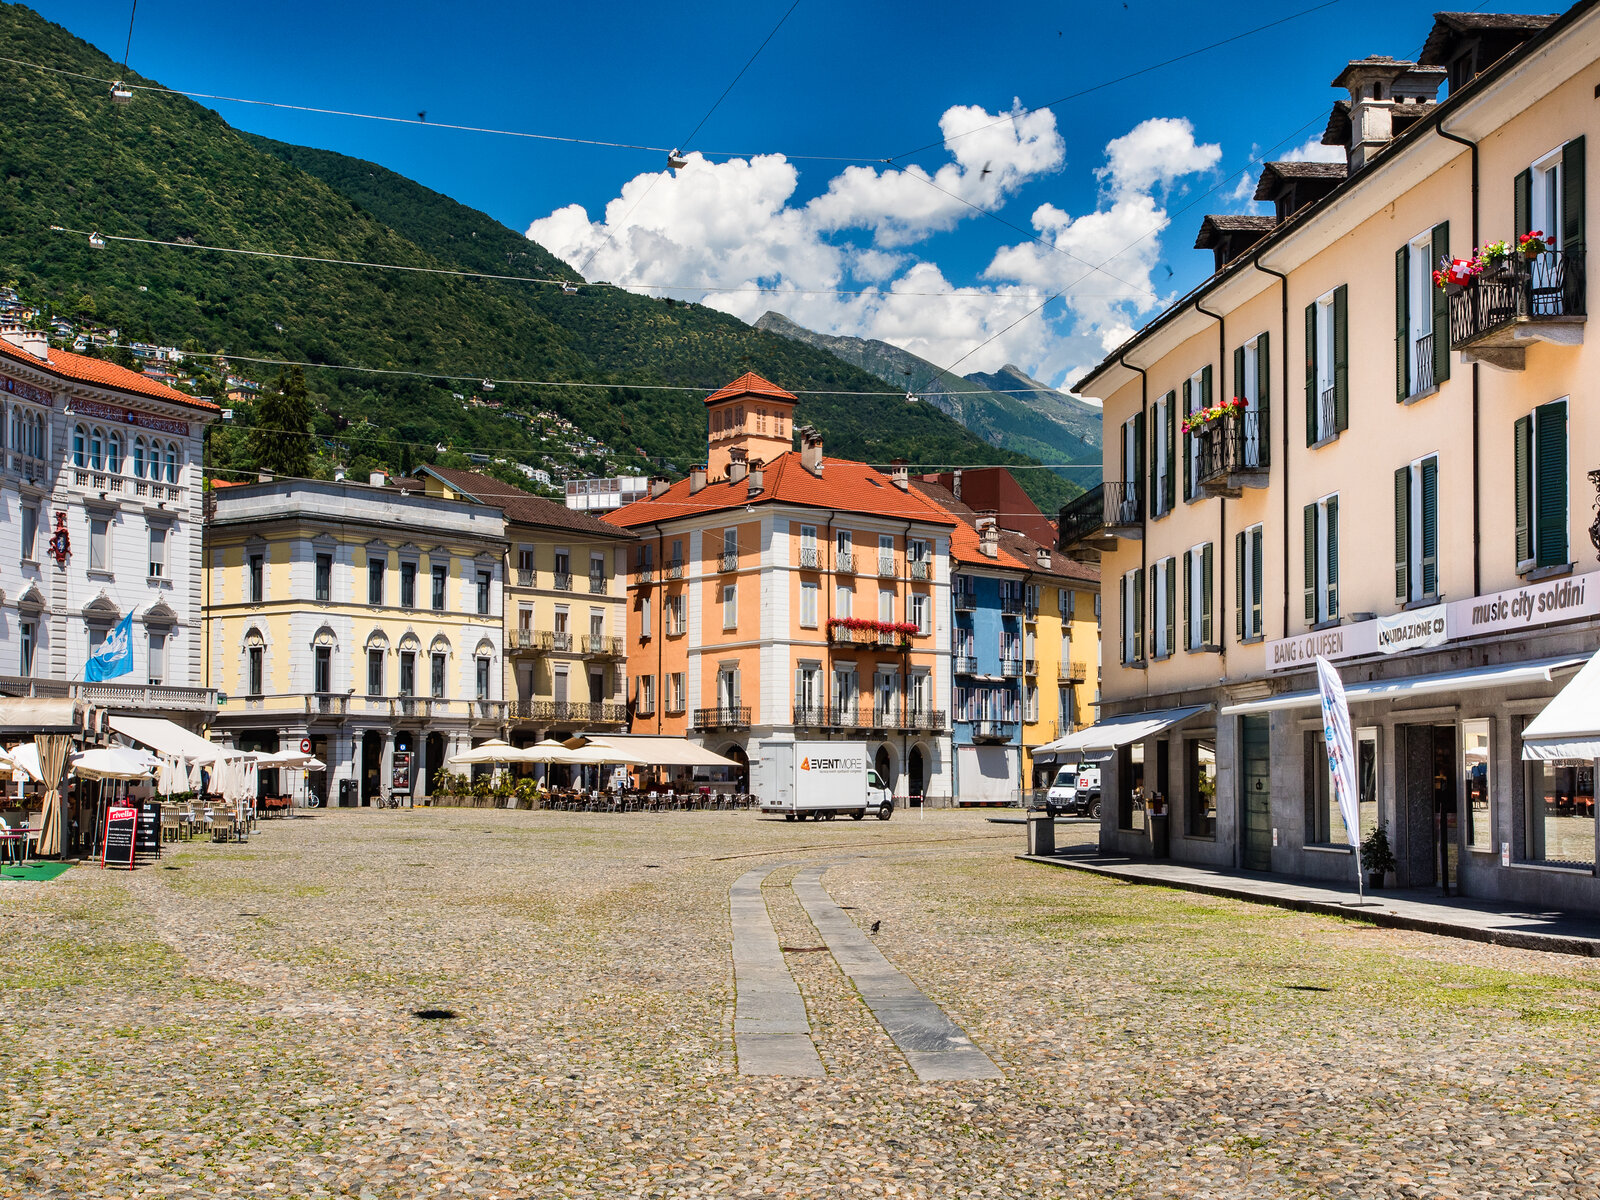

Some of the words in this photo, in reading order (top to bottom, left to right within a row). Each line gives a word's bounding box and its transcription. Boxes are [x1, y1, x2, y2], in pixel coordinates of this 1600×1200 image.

[1472, 595, 1509, 625] music
[1511, 591, 1535, 622] city
[1537, 578, 1585, 612] soldini
[1379, 620, 1431, 647] LIQUIDAZIONE
[1433, 617, 1445, 634] CD
[1274, 641, 1296, 664] BANG
[1299, 641, 1304, 660] &
[1306, 632, 1343, 658] OLUFSEN
[811, 758, 862, 770] EVENTMORE
[112, 810, 133, 819] rivella
